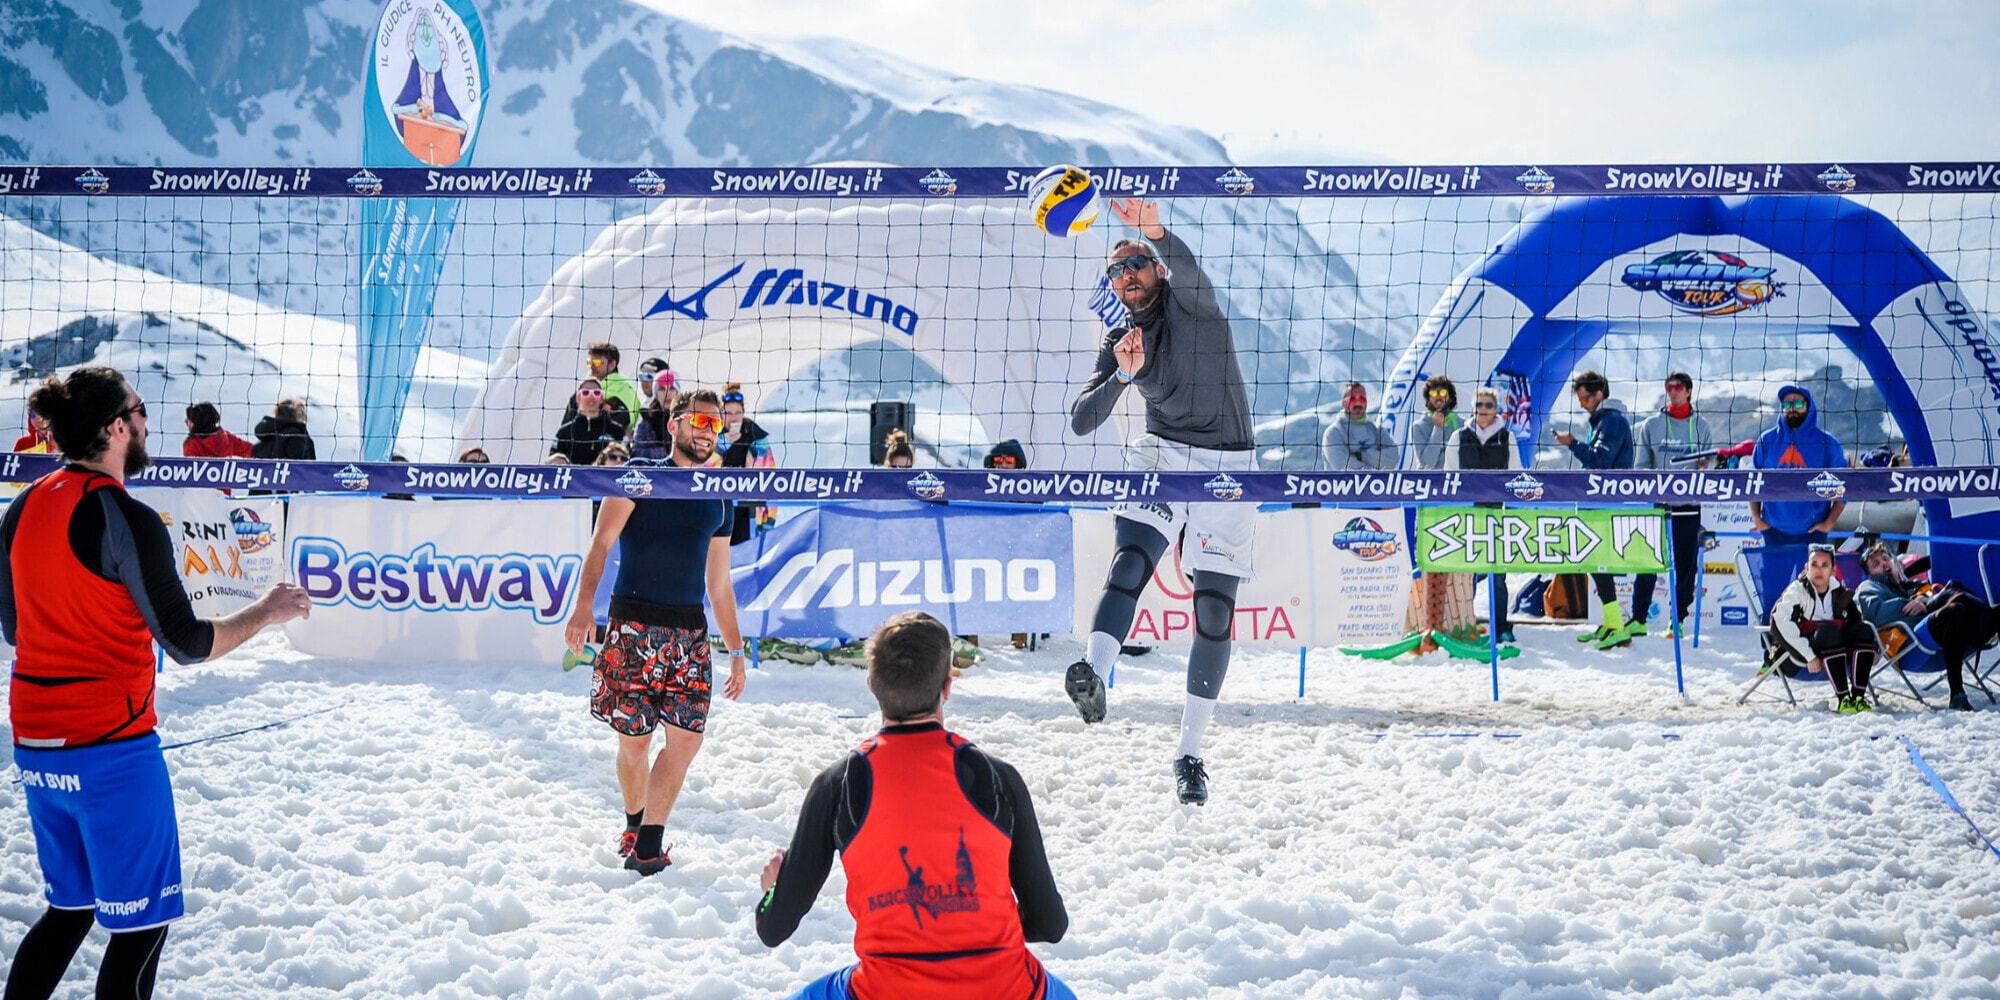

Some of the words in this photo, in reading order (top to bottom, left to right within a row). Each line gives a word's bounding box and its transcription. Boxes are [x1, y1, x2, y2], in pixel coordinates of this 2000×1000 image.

[381, 0, 413, 48] GIUDICE
[433, 3, 452, 27] PH
[450, 26, 477, 103] NEUTRO
[150, 169, 311, 195] SnowVolley.it
[425, 169, 593, 196] SnowVolley.it
[710, 169, 883, 196] SnowVolley.it
[1303, 167, 1481, 195] SnowVolley.it
[1605, 165, 1784, 192] SnowVolley.it
[1624, 264, 1777, 282] SNOW
[1683, 290, 1726, 304] TOUR
[405, 466, 572, 494] SnowVolley.it
[690, 470, 863, 498] SnowVolley.it
[984, 472, 1161, 500] SnowVolley.it
[1284, 472, 1462, 500] SnowVolley.it
[1587, 472, 1765, 500] SnowVolley.it
[1889, 468, 2000, 493] SnowVol
[182, 521, 227, 541] RENT
[1424, 513, 1603, 564] SHRED
[299, 544, 576, 618] Bestway
